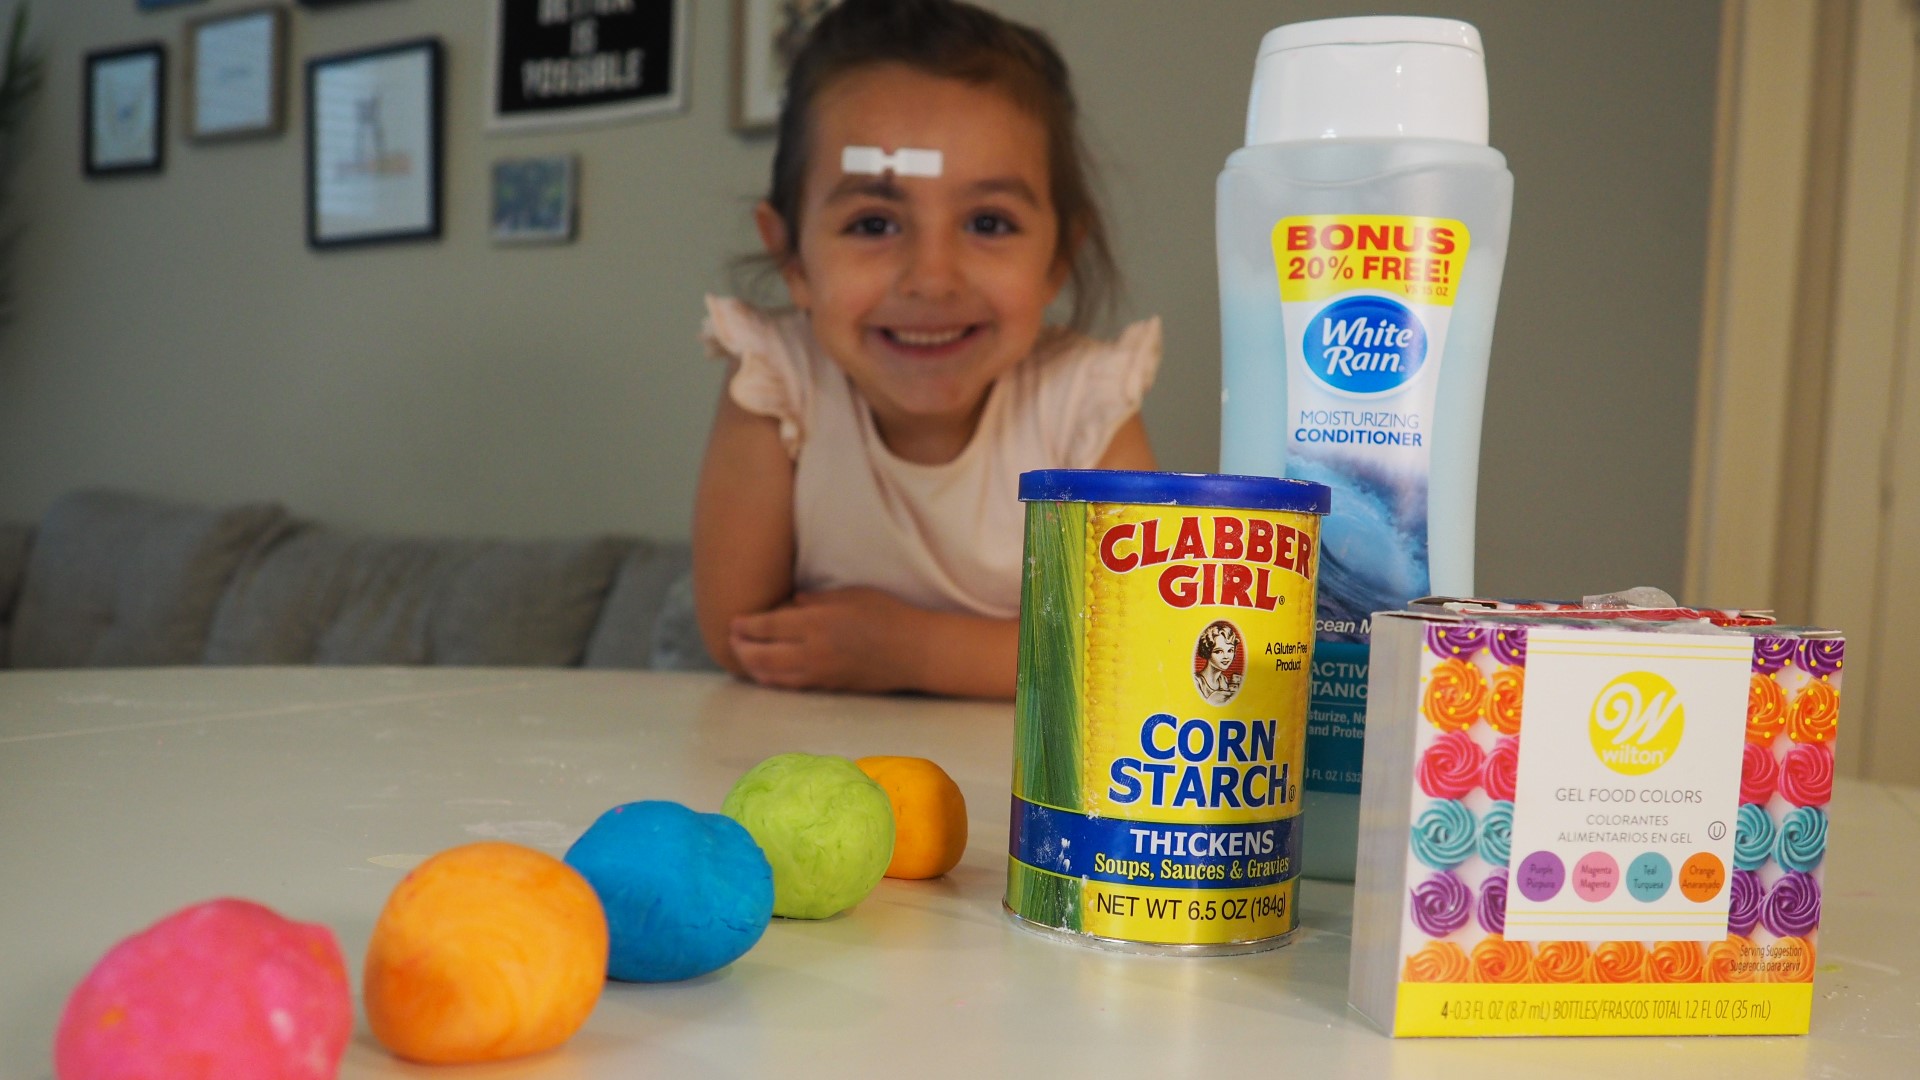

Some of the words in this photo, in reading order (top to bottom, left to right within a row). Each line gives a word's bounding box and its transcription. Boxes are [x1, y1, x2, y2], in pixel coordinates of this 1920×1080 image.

[1287, 224, 1455, 254] BONUS
[1288, 255, 1353, 280] 20%
[1362, 256, 1449, 283] FREE!
[1435, 286, 1449, 297] OZ
[1322, 317, 1413, 348] White
[1300, 410, 1419, 429] MOISTURIZING
[1295, 428, 1422, 446] CONDITIONER
[1100, 516, 1312, 580] CLABBER
[1158, 563, 1278, 611] GIRL
[1314, 619, 1355, 633] cean
[1265, 642, 1272, 655] A
[1274, 642, 1296, 655] Gluten
[1297, 642, 1307, 654] Free
[1276, 659, 1301, 671] Product
[1311, 661, 1368, 679] ACTIV
[1311, 681, 1368, 699] TANIC
[1308, 710, 1350, 725] sturize,
[1140, 713, 1277, 763] CORN
[1308, 725, 1329, 736] and
[1333, 726, 1365, 739] Prote
[1602, 744, 1664, 765] wilton
[1108, 757, 1289, 809] STARCH
[1312, 769, 1323, 780] FL
[1325, 770, 1338, 781] OZ
[1555, 788, 1584, 803] GEL
[1590, 788, 1635, 803] FOOD
[1640, 789, 1702, 804] COLORS
[1586, 814, 1669, 826] COLORANTES
[1130, 829, 1274, 857] THICKENS
[1557, 832, 1648, 844] ALIMENTARIOS
[1651, 833, 1667, 844] EN
[1670, 833, 1692, 844] GEL
[1095, 853, 1155, 880] Soups,
[1161, 859, 1225, 880] Sauces
[1230, 861, 1243, 880] &
[1247, 855, 1289, 878] Gravies
[1581, 865, 1612, 878] Magenta
[1644, 865, 1657, 875] Teal
[1689, 865, 1716, 878] Orange
[1580, 880, 1611, 892] Magenta
[1634, 879, 1664, 891] Turquesa
[1097, 893, 1140, 916] NET
[1146, 898, 1182, 920] WT
[1188, 900, 1216, 921] 6.5
[1222, 899, 1248, 920] OZ
[1250, 893, 1286, 923] (184g)
[1740, 945, 1765, 958] Serving
[1766, 945, 1802, 958] Suggestion
[1730, 959, 1765, 973] Sugerencia
[1767, 962, 1781, 973] para
[1782, 960, 1800, 972] servir
[1473, 1000, 1484, 1020] FL
[1488, 1000, 1504, 1020] OZ
[1506, 1000, 1527, 1022] (8.7
[1529, 1001, 1550, 1021] mL)
[1653, 1000, 1682, 1019] TOTAL
[1685, 1000, 1698, 1019] 1.2
[1701, 1000, 1712, 1019] FL
[1716, 1000, 1729, 1019] OZ
[1731, 1000, 1748, 1021] (35
[1751, 1000, 1771, 1021] mL)
